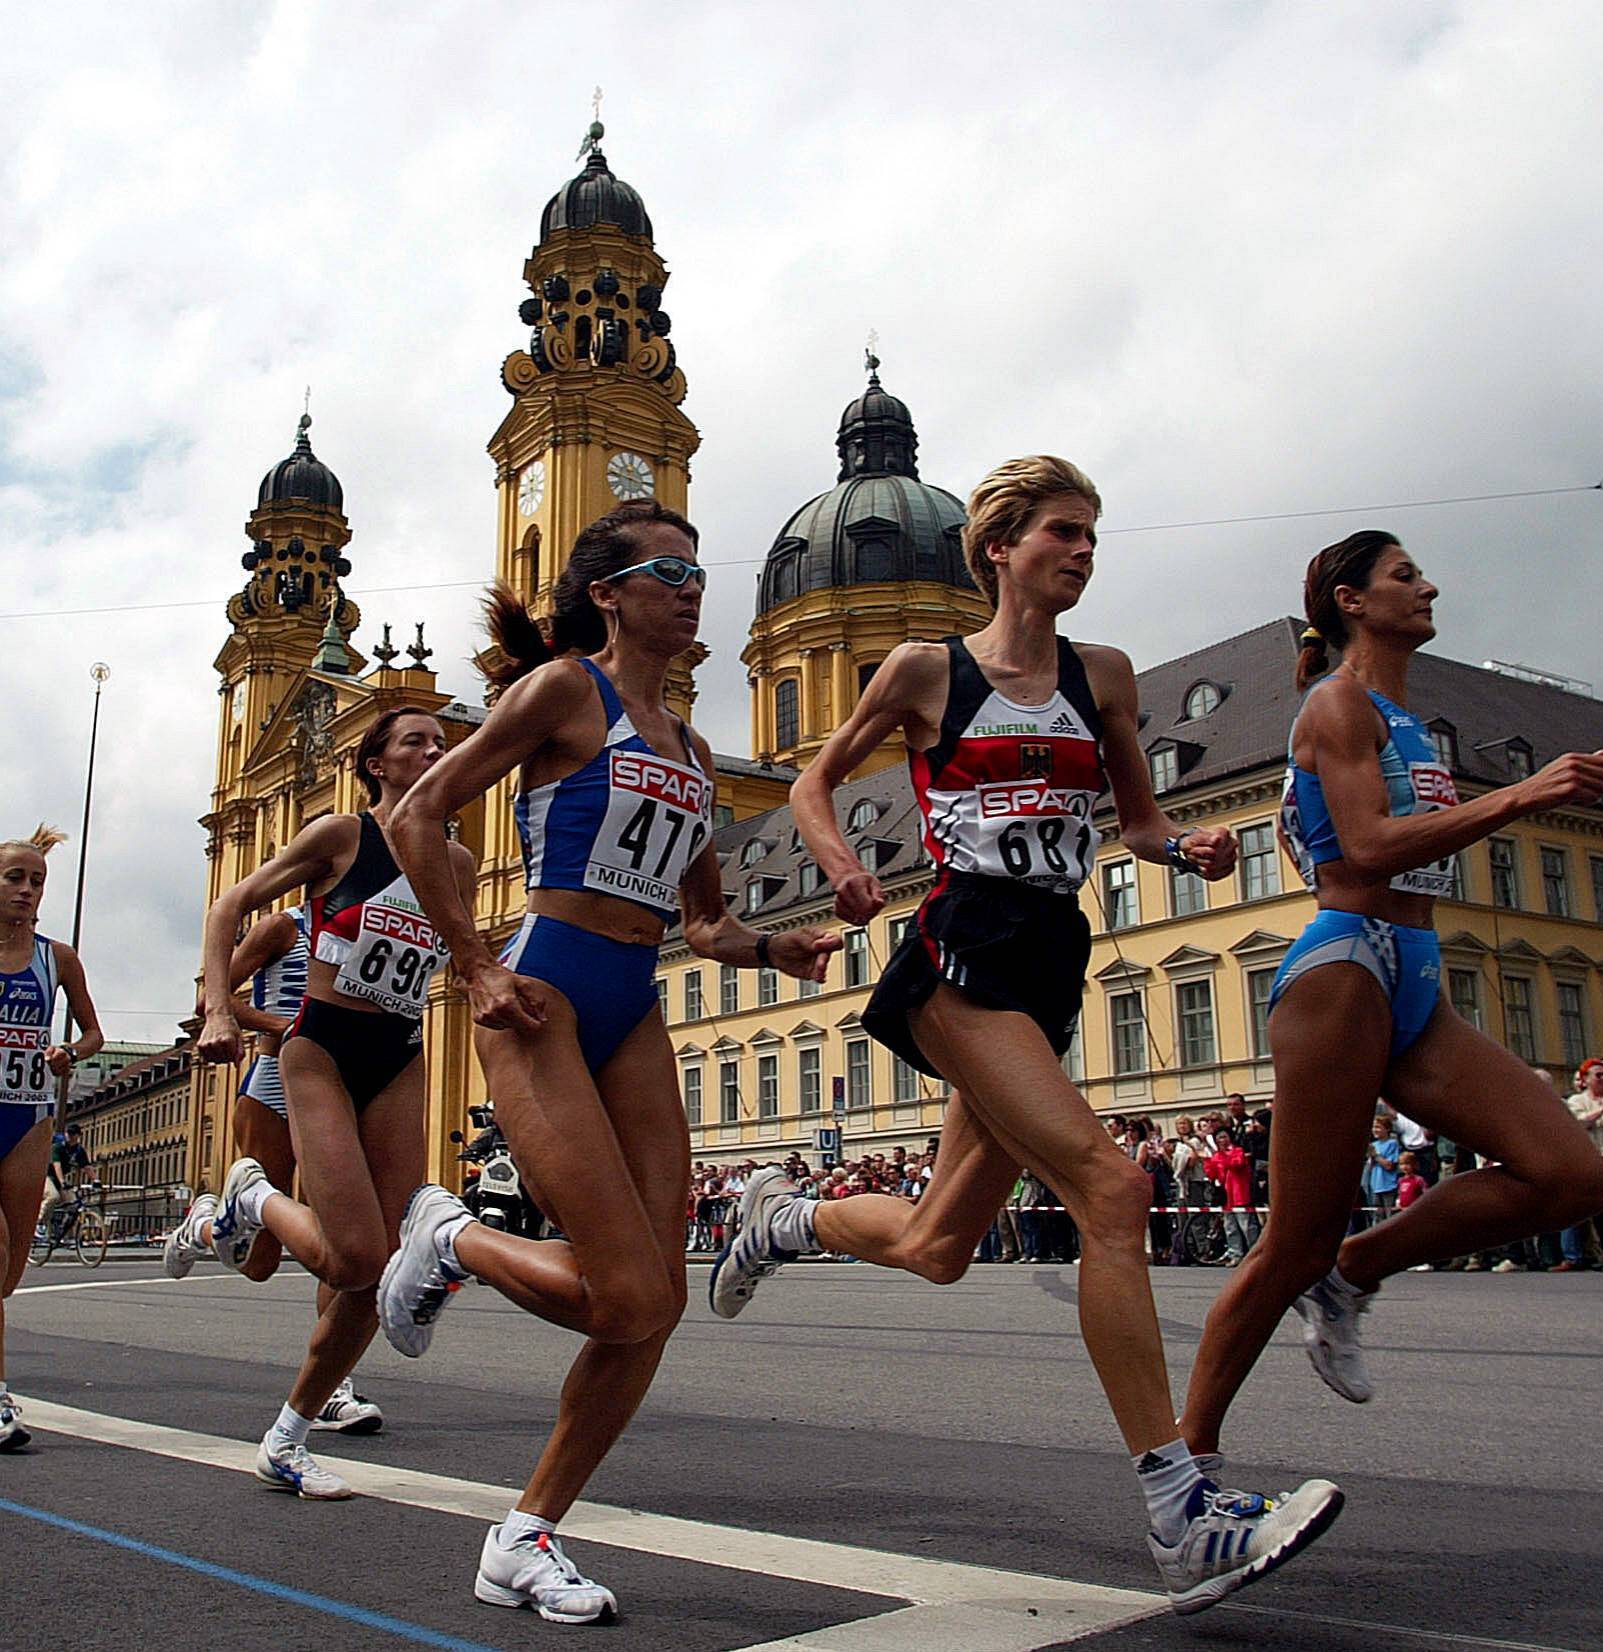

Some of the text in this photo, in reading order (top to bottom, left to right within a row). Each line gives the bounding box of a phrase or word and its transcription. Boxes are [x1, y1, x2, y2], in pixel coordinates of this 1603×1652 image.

[973, 723, 1039, 736] FUJIFILM
[614, 760, 701, 808] SPAR
[997, 817, 1091, 880] 681
[597, 867, 668, 902] MUNICH
[366, 910, 433, 947] SPAR
[342, 980, 401, 1011] MUNICH
[0, 1004, 40, 1024] ALIA
[0, 1049, 45, 1090] 58
[821, 1131, 834, 1148] U
